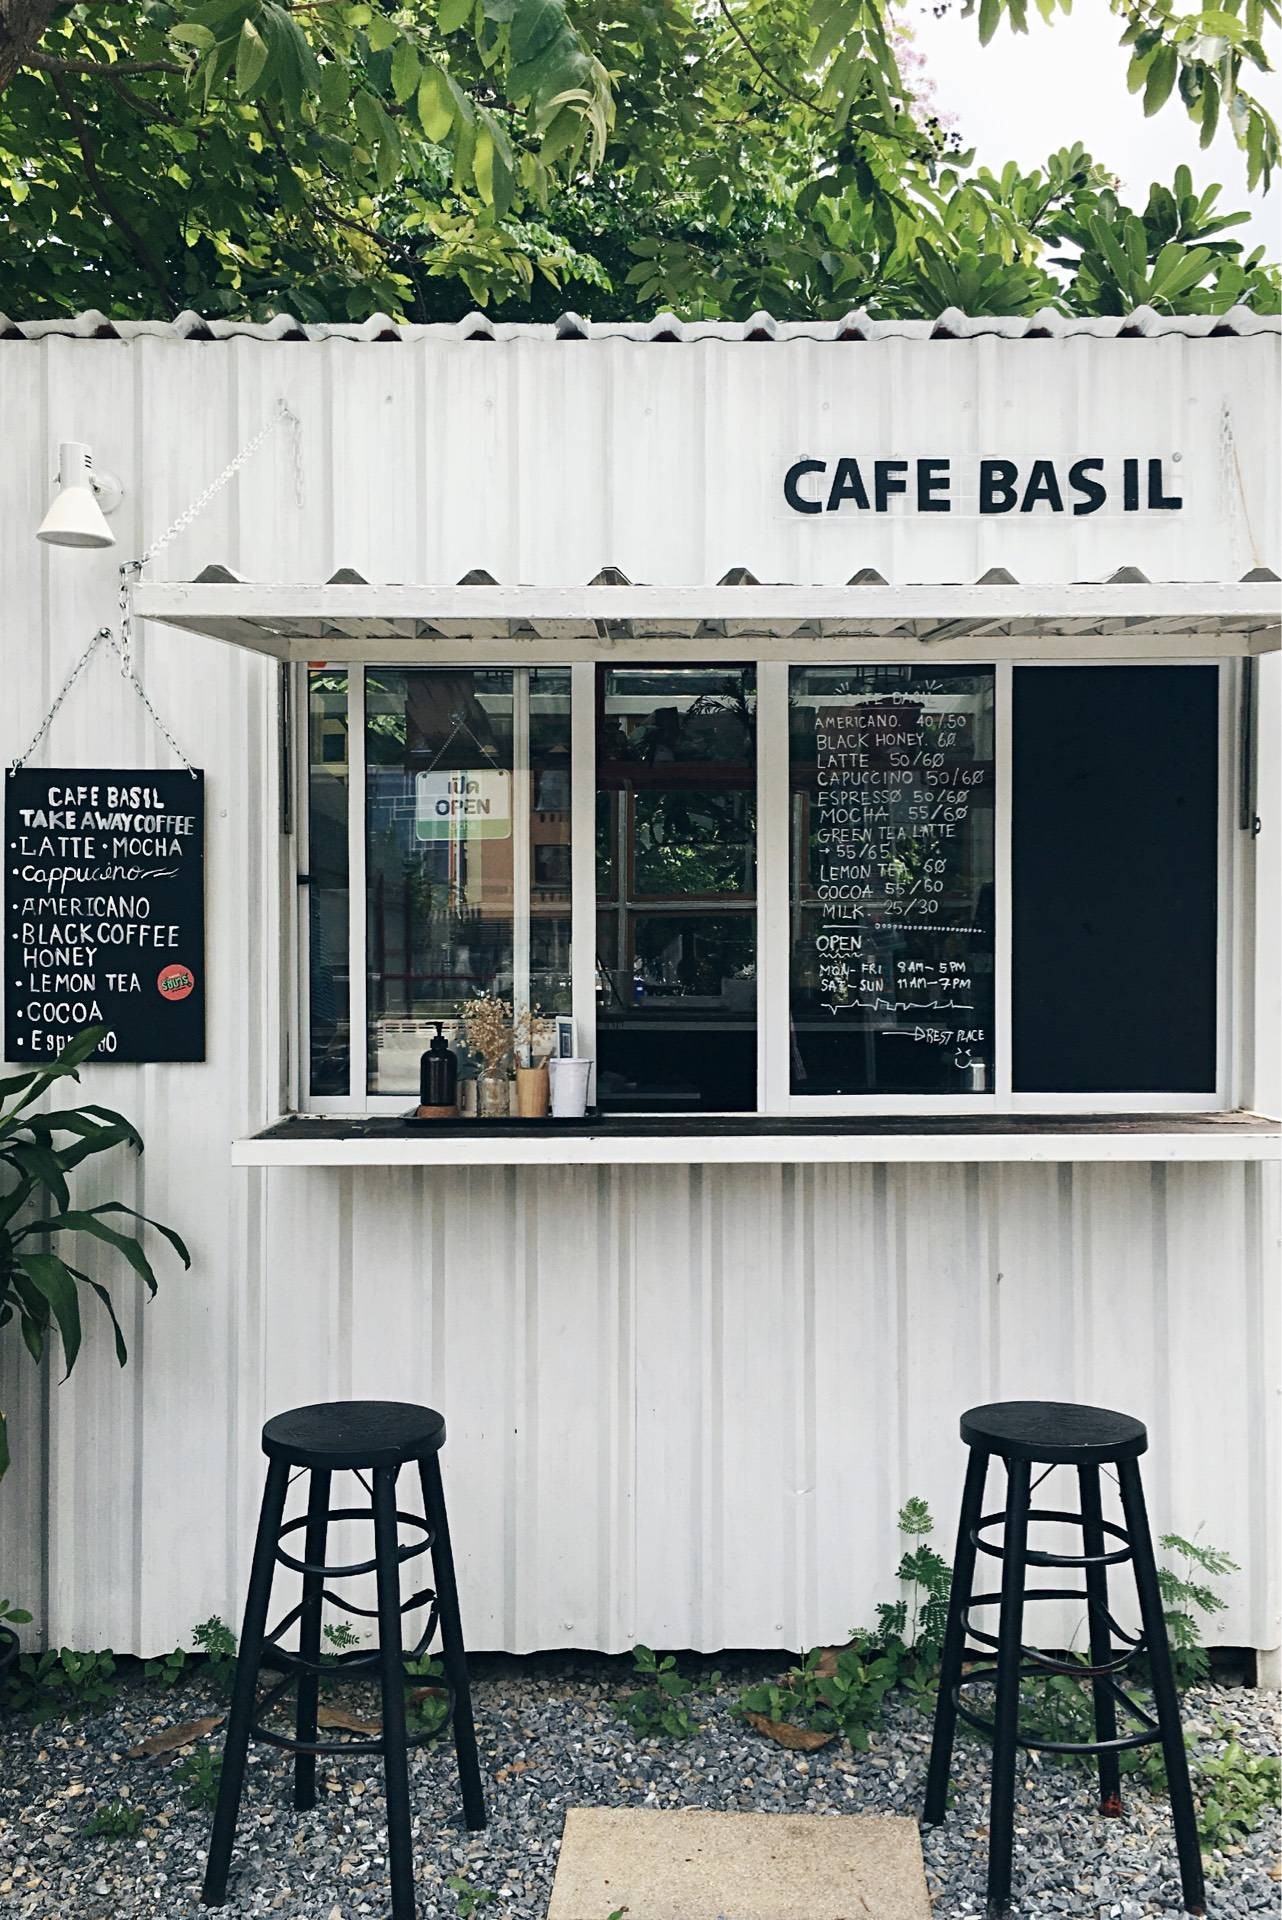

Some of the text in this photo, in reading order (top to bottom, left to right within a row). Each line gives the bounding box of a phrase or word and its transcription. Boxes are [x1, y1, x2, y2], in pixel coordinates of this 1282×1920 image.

[784, 458, 1183, 515] CAFE BASIL
[816, 733, 870, 750] BLACK
[817, 753, 870, 769] LATTE
[817, 771, 913, 786] CAPUCCINO
[48, 786, 165, 809] CAFE BASIL
[435, 798, 491, 816] OPEN
[19, 809, 77, 830] TAKE
[819, 806, 890, 824] MOCHA
[817, 823, 957, 843] GREEN TEA LATTE
[19, 836, 183, 859] LATTE MOCHA
[836, 843, 890, 860] 55/65
[820, 864, 872, 882] LEMON
[877, 862, 910, 878] TEA
[817, 879, 944, 900] COCOA 55/60
[21, 895, 150, 919] AMERICANO
[884, 897, 939, 916] 25/30
[816, 935, 863, 952] OPEN
[23, 947, 98, 968] HONEY
[30, 973, 96, 993] LEMON
[105, 973, 142, 993] TEA
[26, 1000, 104, 1024] COCOA
[926, 1029, 985, 1046] REST PLACE
